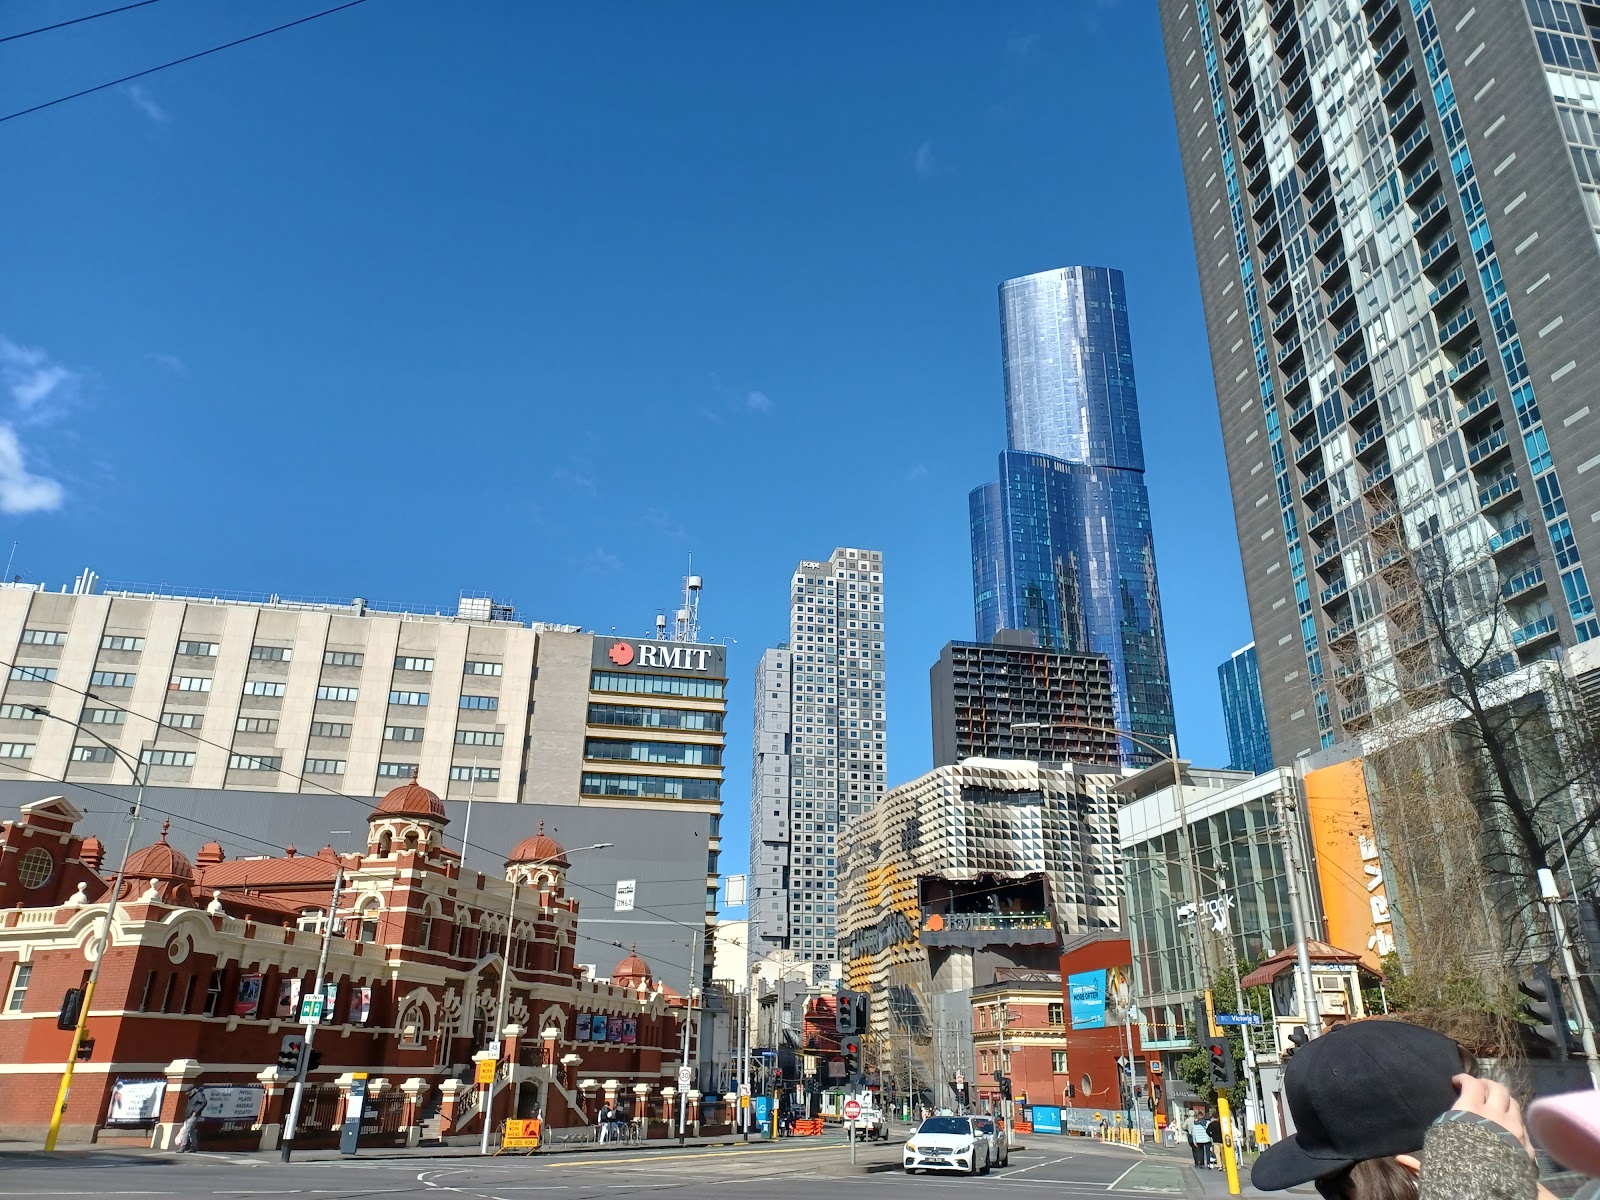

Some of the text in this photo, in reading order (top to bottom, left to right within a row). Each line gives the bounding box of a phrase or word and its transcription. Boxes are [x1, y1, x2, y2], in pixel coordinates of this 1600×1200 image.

[636, 644, 712, 671] RMIT
[616, 899, 633, 907] ONLY
[947, 913, 994, 930] RMIT
[1085, 991, 1099, 1000] OFTEN
